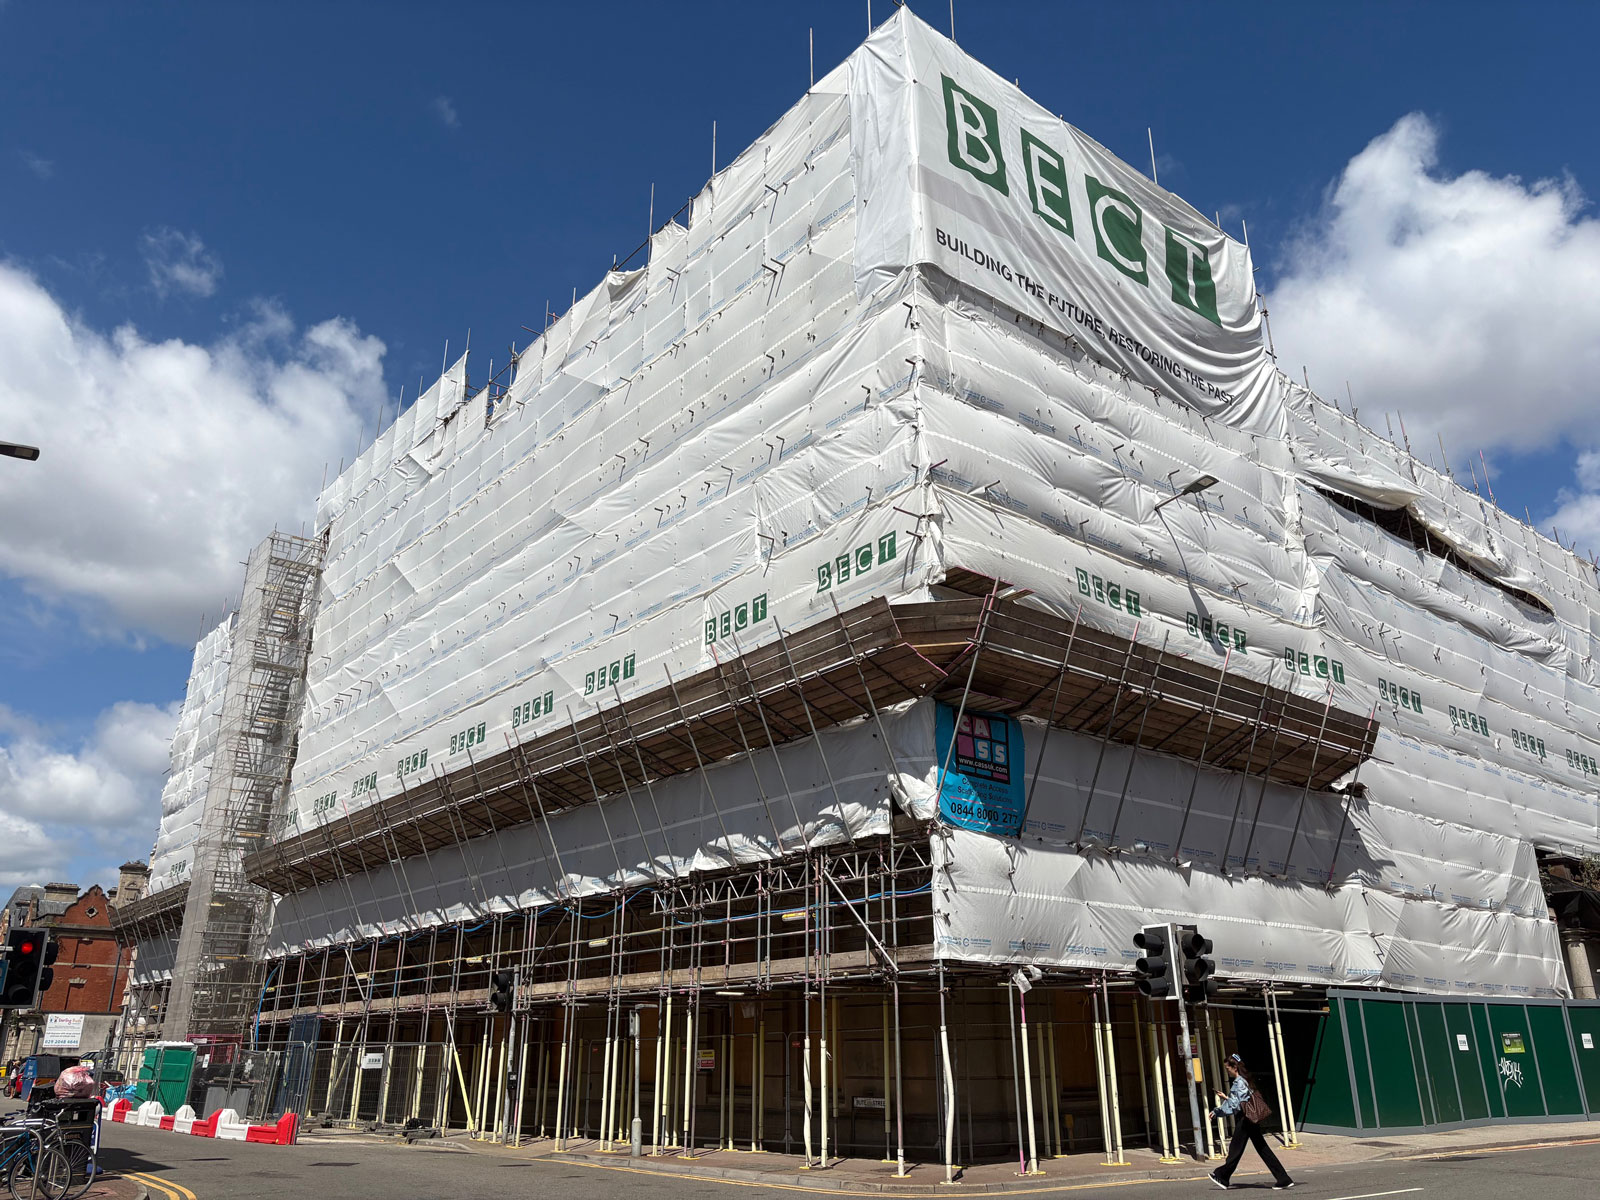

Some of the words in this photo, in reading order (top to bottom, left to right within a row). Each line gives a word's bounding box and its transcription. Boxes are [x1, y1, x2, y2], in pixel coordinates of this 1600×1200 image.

[941, 72, 1223, 329] BECT
[936, 228, 1013, 282] BUILDING
[1015, 272, 1045, 300] THE
[1048, 293, 1106, 340] FUTURE,
[1108, 327, 1183, 378] RESTORING
[1183, 368, 1206, 391] THE
[1206, 382, 1234, 406] PAST
[817, 530, 897, 594] BECT
[1075, 567, 1142, 618] BECT
[705, 593, 767, 645] BECT
[1186, 611, 1248, 655] BECT
[584, 653, 635, 696] BECT
[1284, 647, 1345, 685] BECT
[512, 690, 553, 729] BECT
[1378, 678, 1423, 714] BECT
[449, 722, 486, 756] BECT
[1449, 705, 1490, 737] BECT
[1511, 729, 1548, 758] BECT
[1566, 748, 1599, 775] BECT
[397, 748, 428, 779] BECT
[958, 757, 1008, 774] www.cassuk.com
[950, 802, 974, 816] 0844
[976, 808, 999, 821] 8000
[1002, 812, 1018, 824] 277
